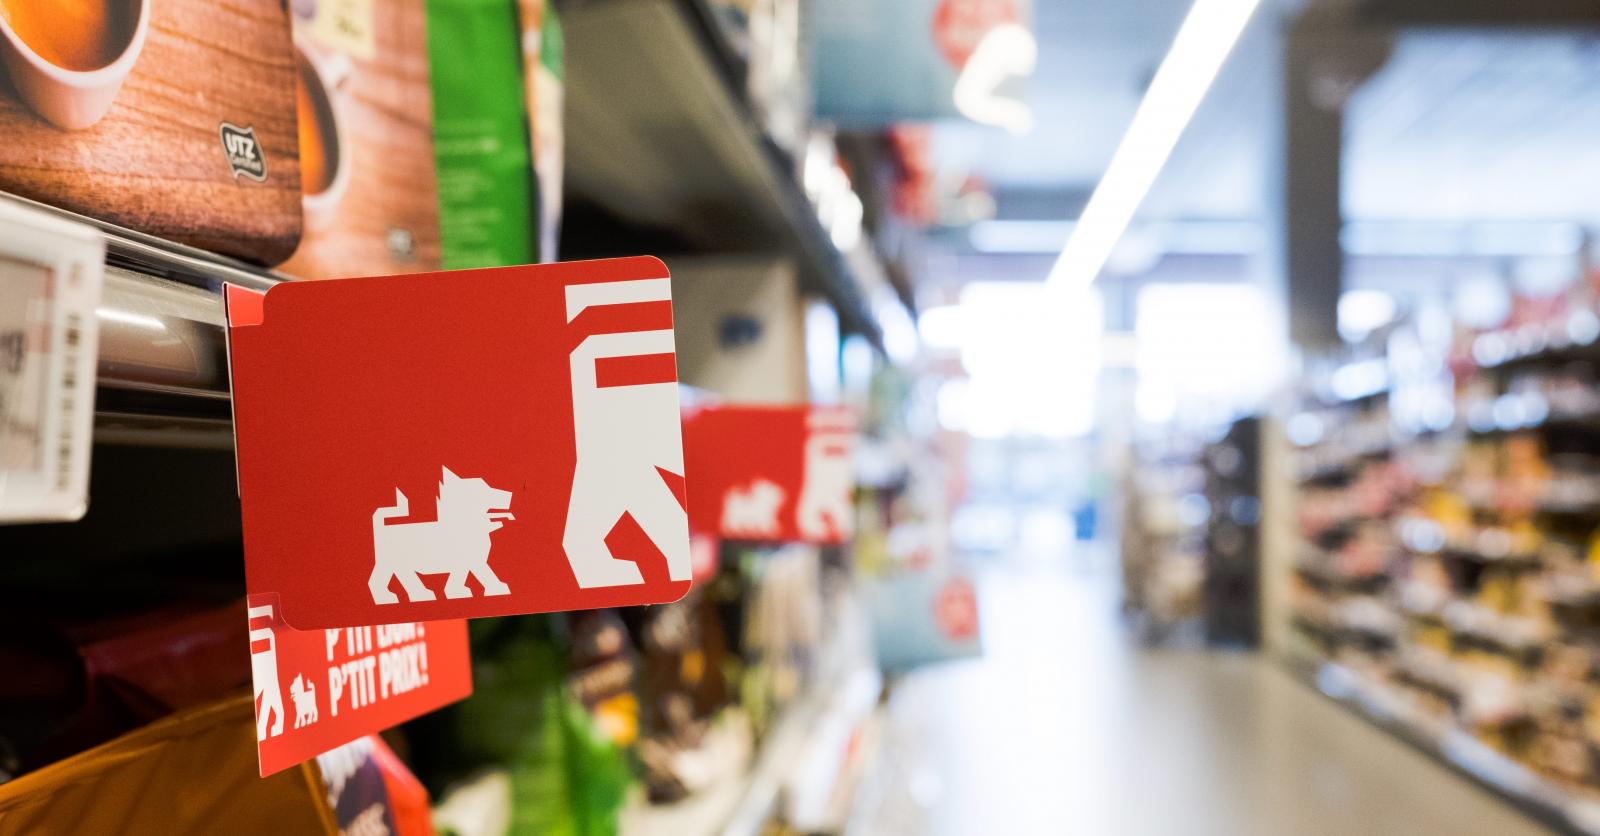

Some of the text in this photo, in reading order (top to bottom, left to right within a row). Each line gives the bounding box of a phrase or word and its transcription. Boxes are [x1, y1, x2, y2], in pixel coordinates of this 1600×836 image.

[225, 132, 256, 159] UTZ
[328, 641, 429, 717] P'TIT PRIX!
